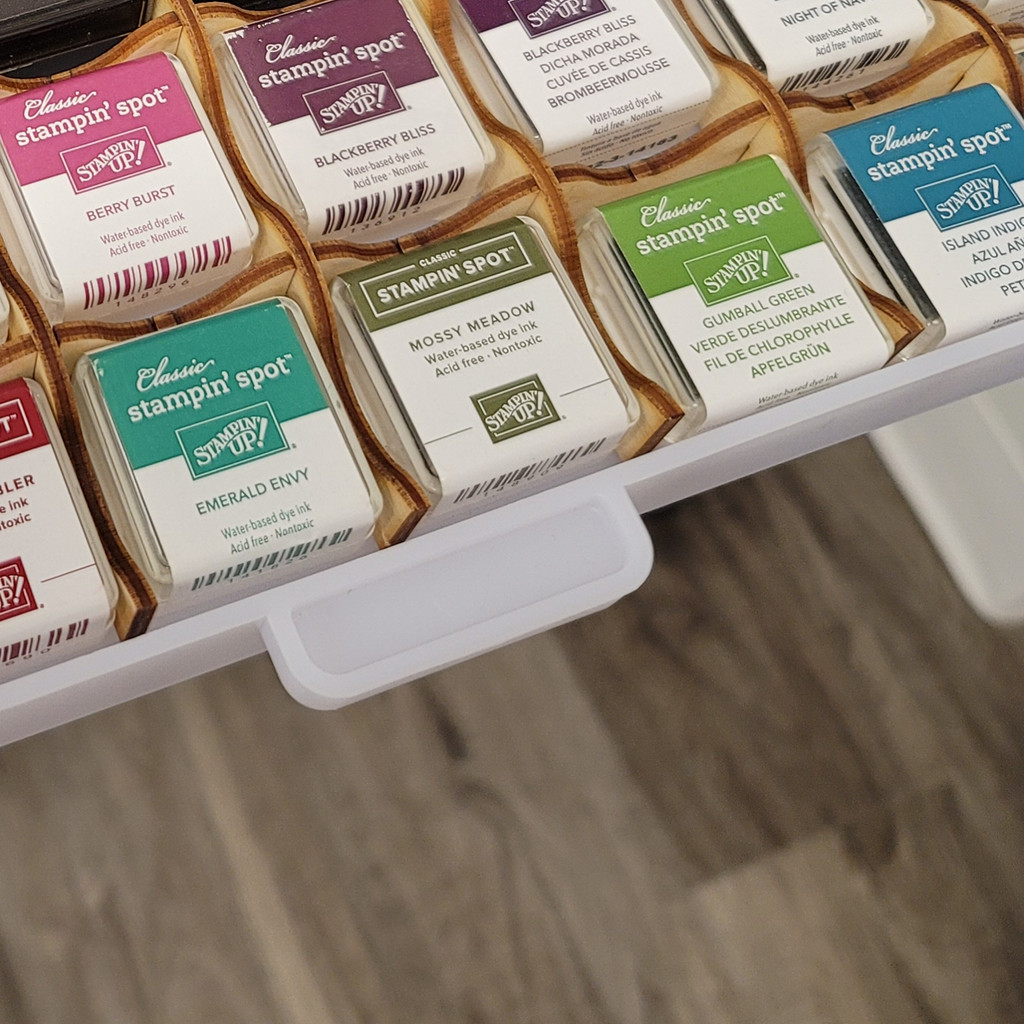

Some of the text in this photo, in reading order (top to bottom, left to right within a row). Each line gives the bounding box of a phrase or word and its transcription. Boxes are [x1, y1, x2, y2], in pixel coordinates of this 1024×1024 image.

[781, 8, 818, 27] NIGHT
[822, 1, 838, 13] OF
[523, 15, 636, 62] BLACKBERRY BLISS
[540, 33, 640, 74] DICHA MORADA
[546, 46, 652, 89] CUVÉE DE CASSIS
[547, 58, 670, 109] BROMBEERMOUSSE
[23, 90, 96, 120] Classic
[109, 141, 145, 173] UP!
[314, 124, 435, 169] BLACKBERRY BLISS
[86, 185, 176, 222] BERRY BURST
[941, 230, 991, 252] ISLAND
[972, 246, 1007, 264] AZUL
[961, 265, 1011, 288] INDIGO
[409, 301, 536, 353] MOSSY MEADOW
[690, 295, 847, 354] VERDE DESLUMBRANTE
[703, 284, 815, 329] GUMBALL GREEN
[705, 313, 855, 372] FIL DE CHLOROPHYLLE
[750, 342, 831, 378] APFELGRÜN
[9, 497, 29, 511] ink
[196, 468, 309, 515] EMERALD ENVY
